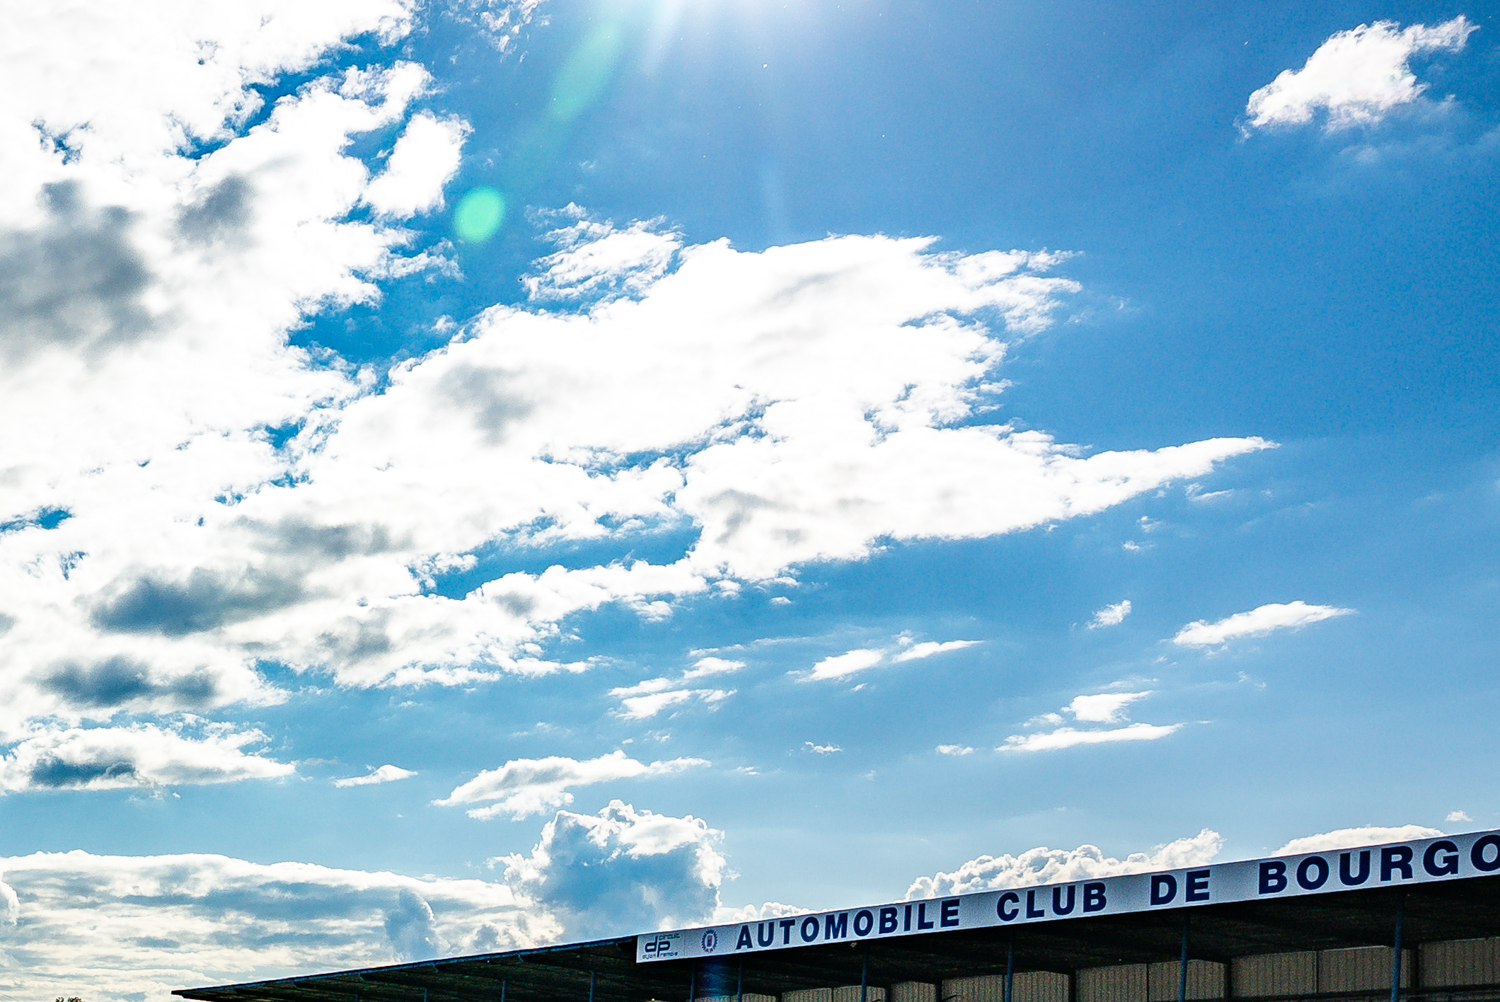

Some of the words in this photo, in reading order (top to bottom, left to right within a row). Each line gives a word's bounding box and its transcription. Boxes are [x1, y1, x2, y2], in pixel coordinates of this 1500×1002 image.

[736, 899, 960, 950] AUTOMOBILE
[996, 882, 1107, 922] CLUB
[1150, 869, 1211, 906] DE
[1258, 834, 1500, 895] BOURGO
